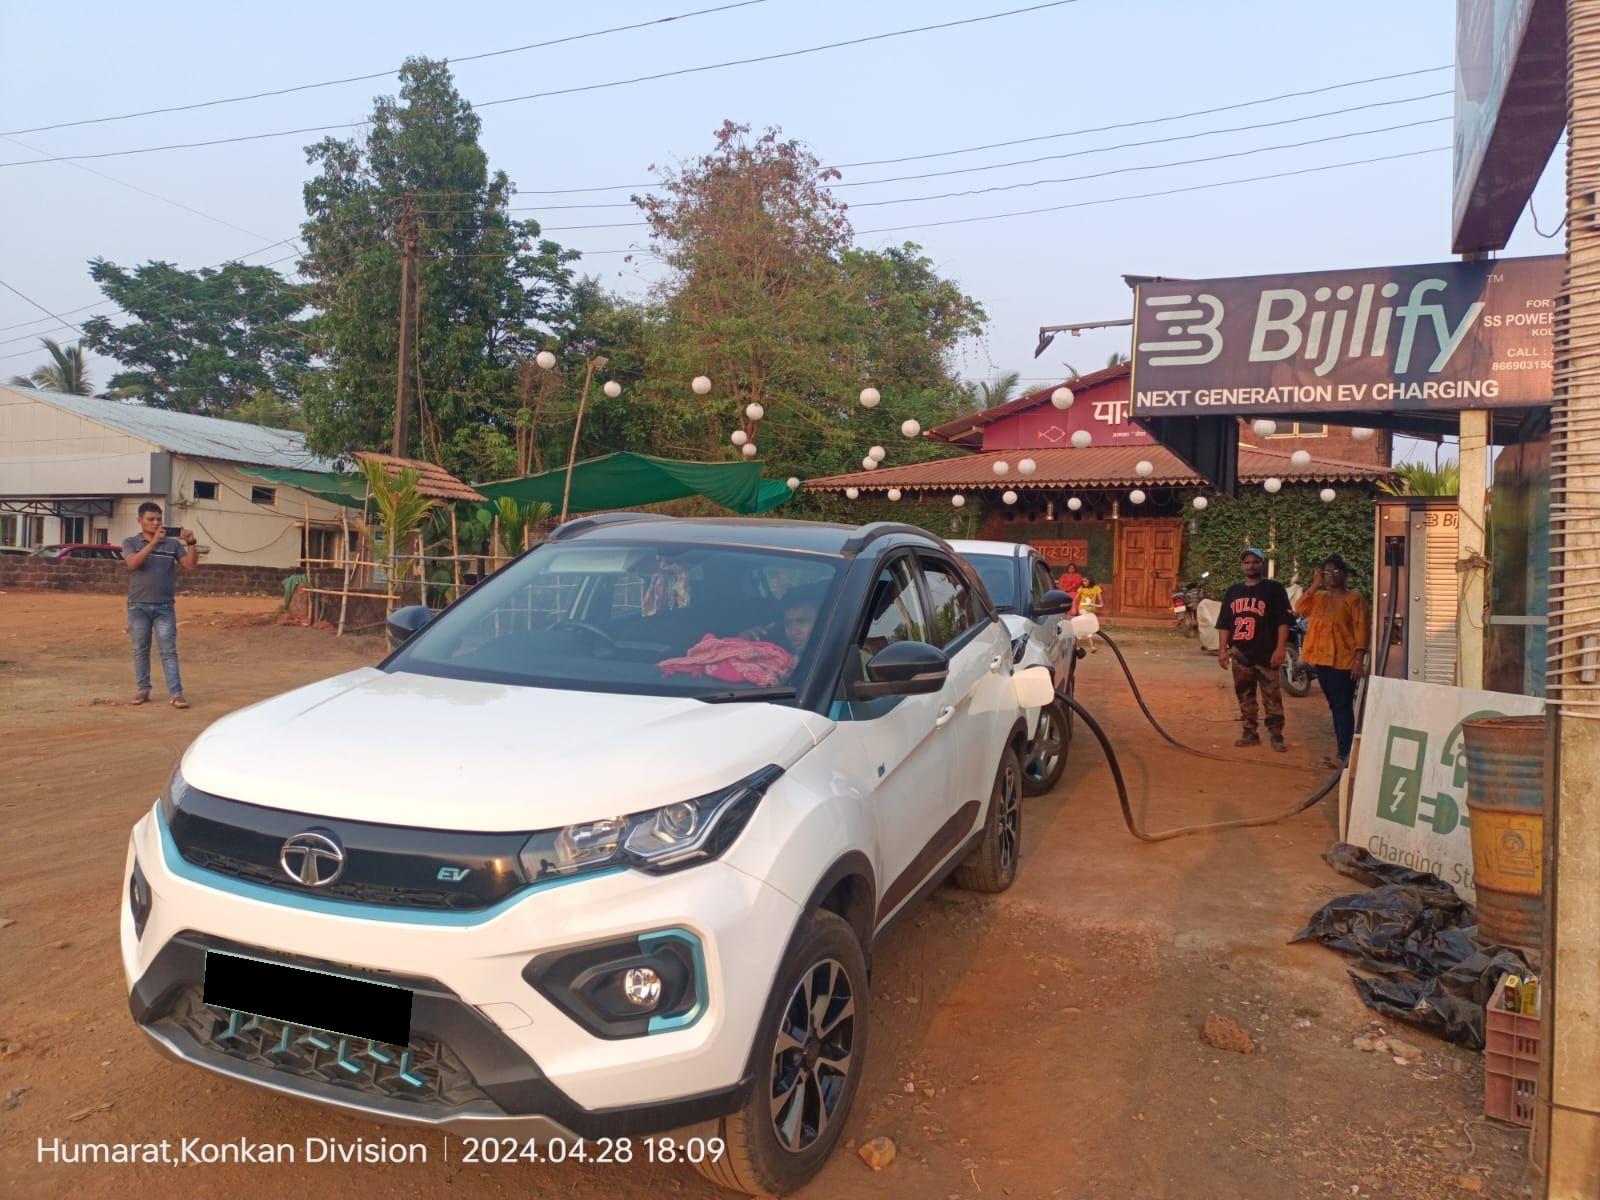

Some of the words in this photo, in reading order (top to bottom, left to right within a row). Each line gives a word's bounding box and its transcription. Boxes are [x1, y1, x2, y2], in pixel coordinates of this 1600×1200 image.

[1526, 299, 1550, 309] FOR
[1248, 278, 1486, 377] Bijlify
[1483, 315, 1502, 328] SS
[1507, 347, 1540, 358] CALL
[1136, 389, 1191, 408] NEXT
[1194, 383, 1332, 406] GENERATION
[1338, 383, 1367, 401] EV
[1372, 379, 1499, 400] CHARGING
[1233, 616, 1256, 641] 23
[1368, 834, 1442, 880] Charging
[437, 866, 470, 881] EV
